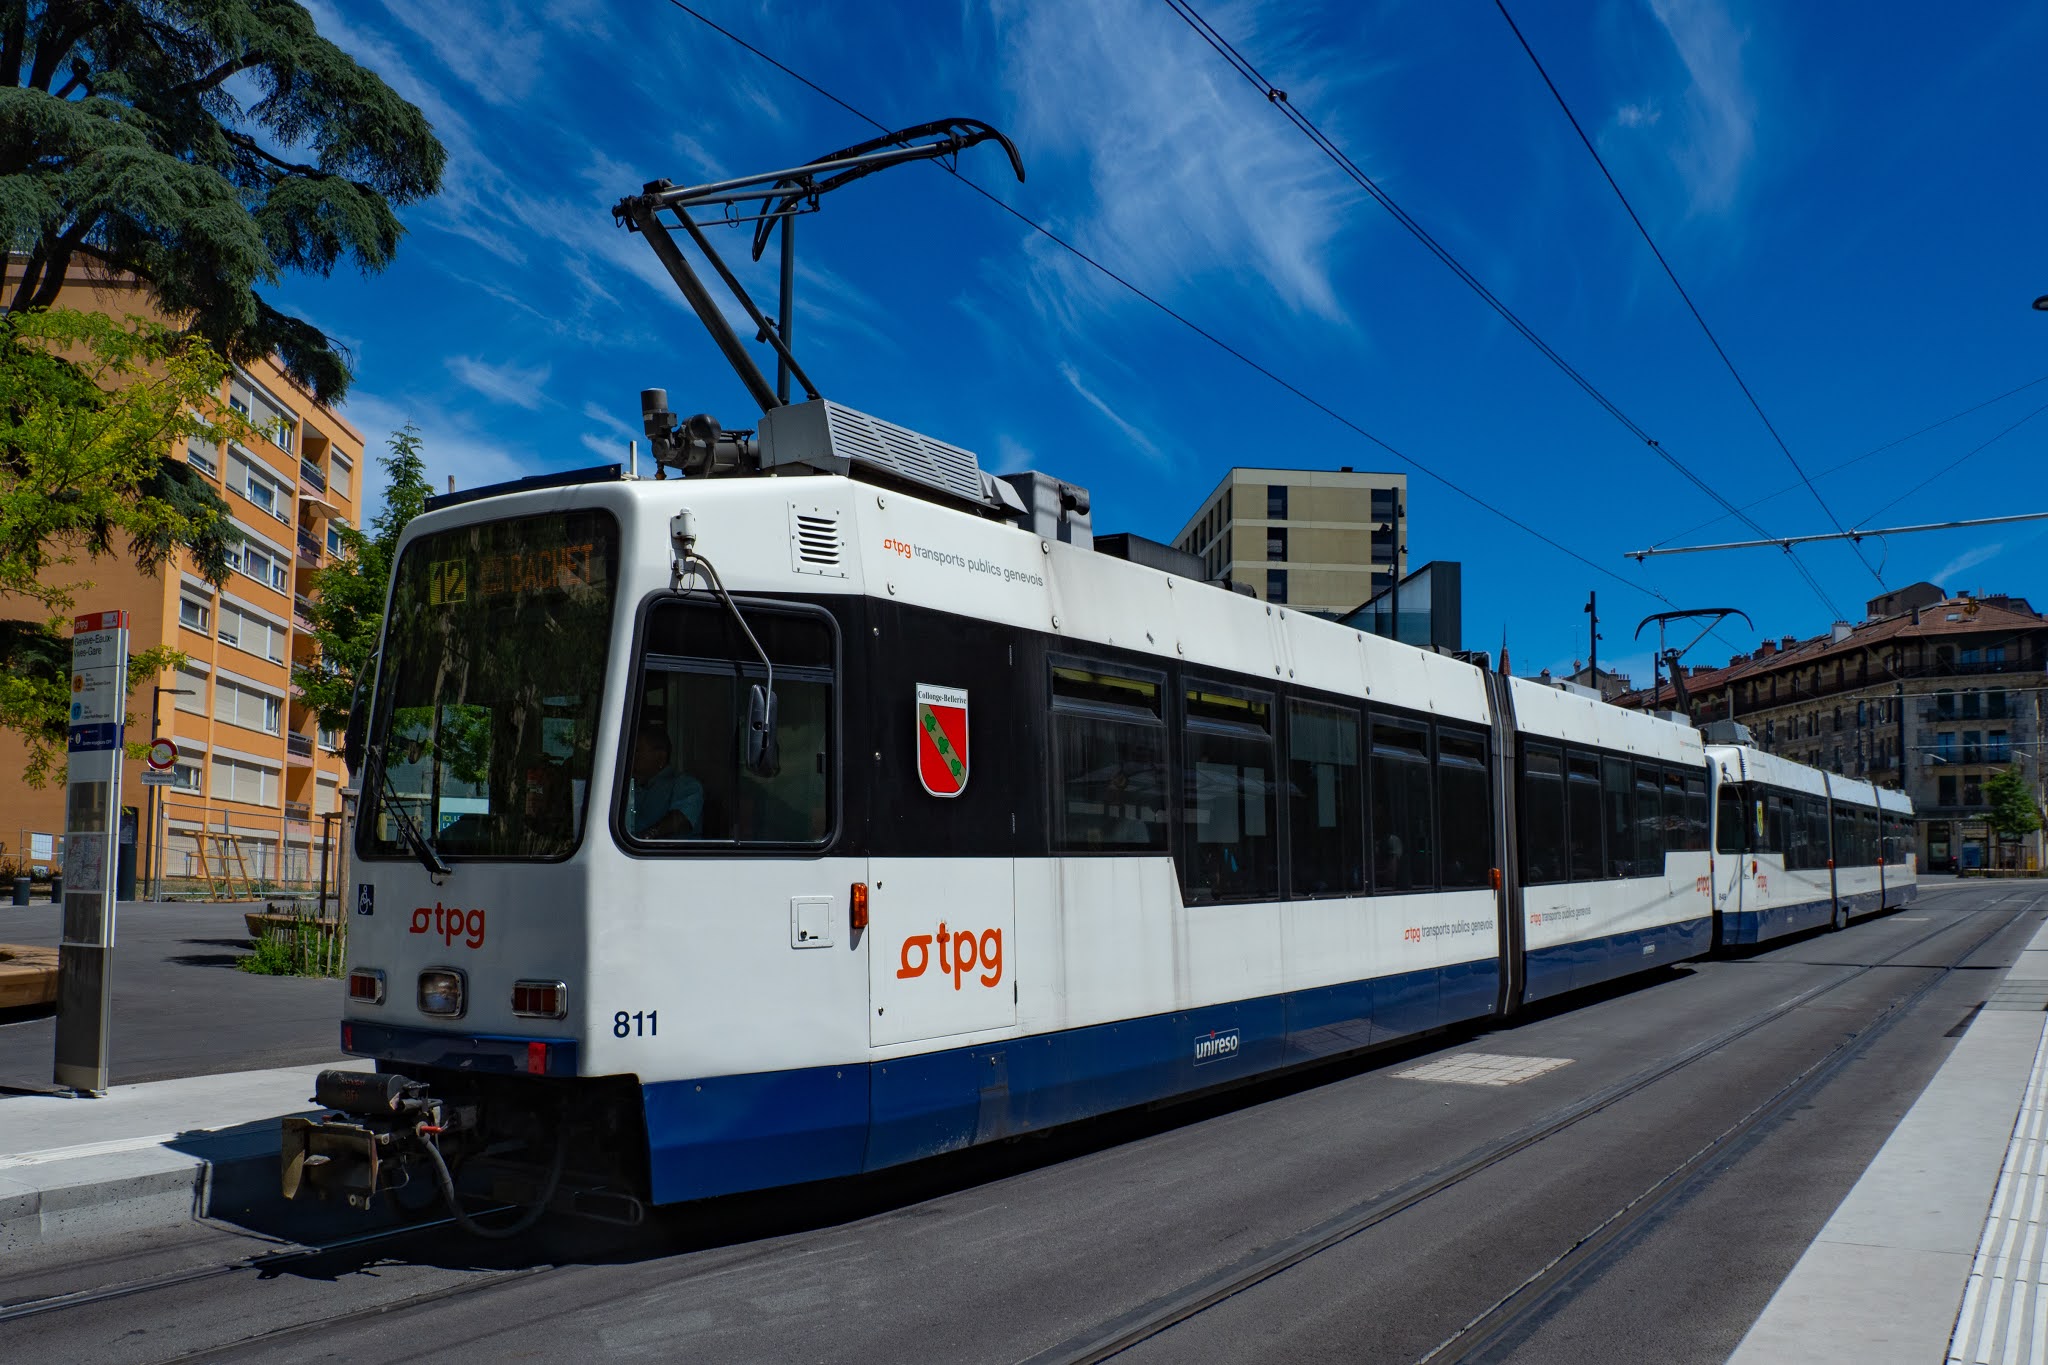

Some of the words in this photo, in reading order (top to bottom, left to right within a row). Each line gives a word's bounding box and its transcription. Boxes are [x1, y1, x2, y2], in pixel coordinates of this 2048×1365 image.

[433, 560, 465, 604] 12
[511, 543, 594, 594] BACHET
[913, 543, 966, 568] transports
[967, 557, 1001, 577] publics
[1003, 567, 1044, 587] genevois
[917, 690, 967, 705] Collonge-Bellerive
[1421, 922, 1450, 940] transports
[1451, 919, 1470, 938] publics
[1470, 919, 1494, 936] genevois
[613, 1009, 658, 1039] 811
[1196, 1031, 1239, 1060] unireso
